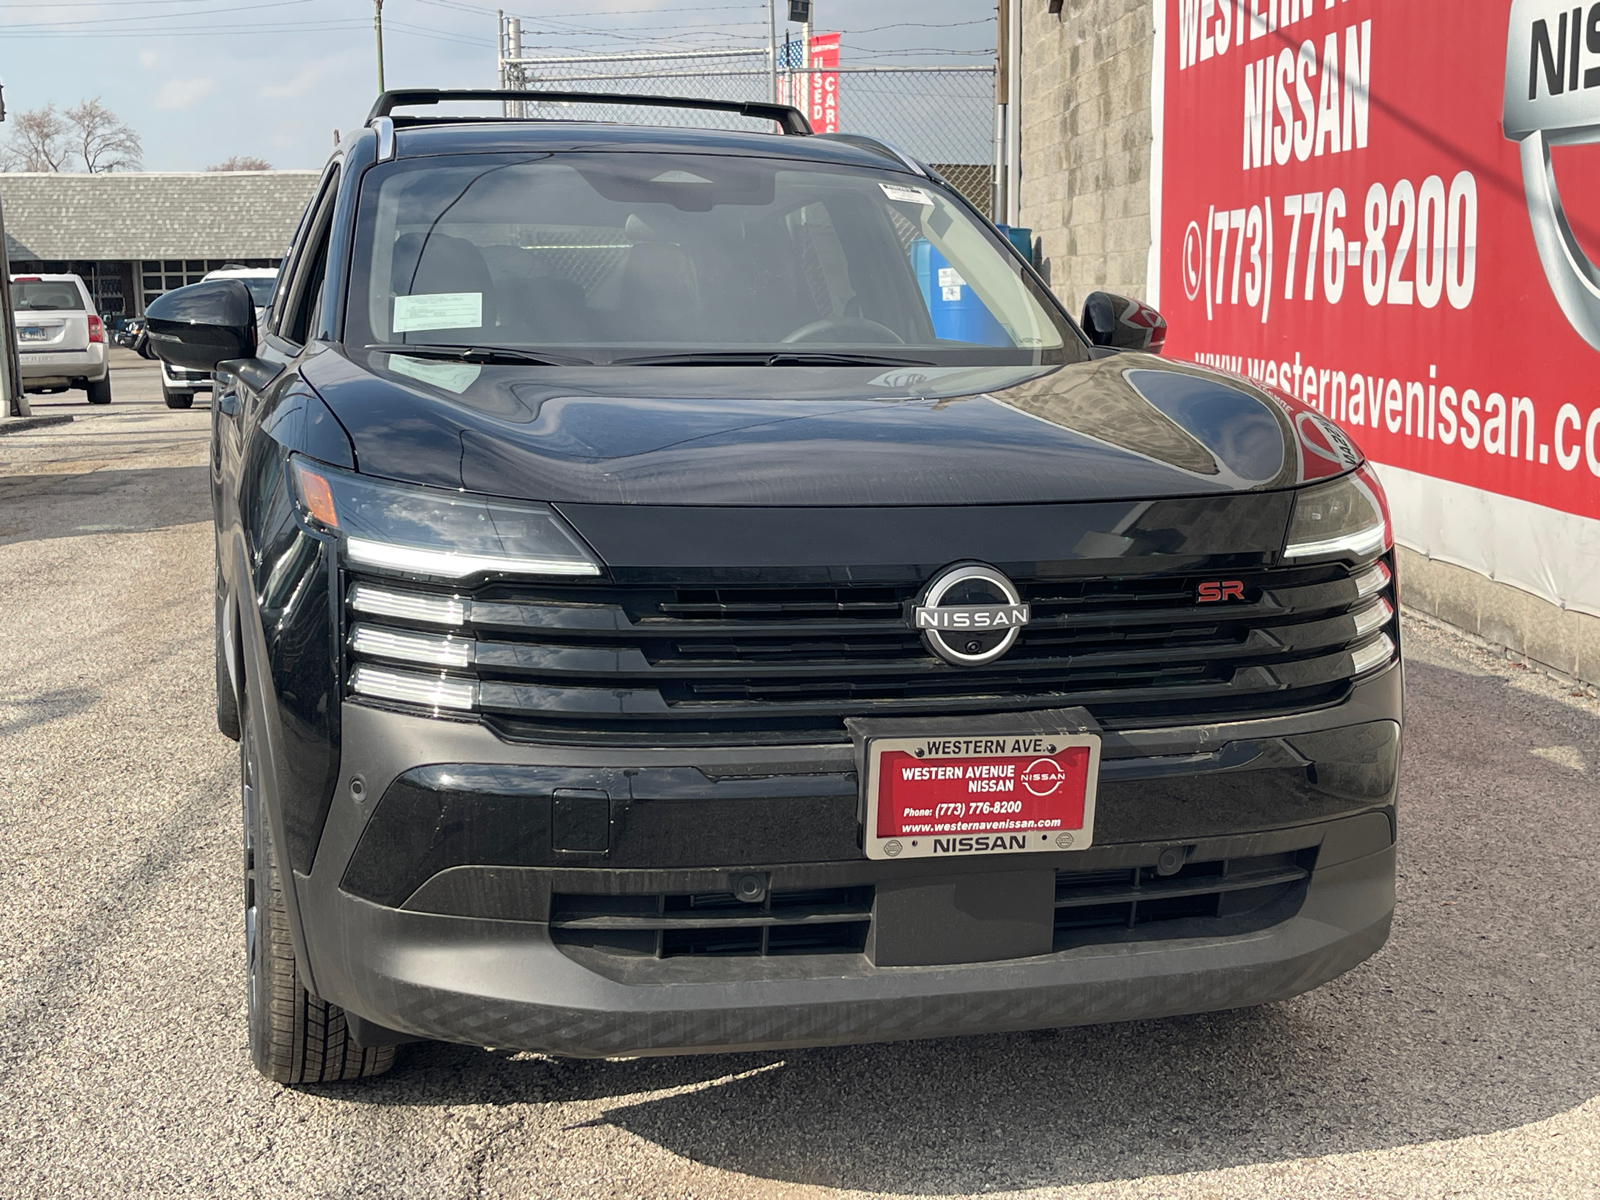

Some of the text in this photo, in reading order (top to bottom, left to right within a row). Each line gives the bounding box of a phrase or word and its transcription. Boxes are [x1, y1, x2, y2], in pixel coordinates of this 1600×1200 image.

[813, 56, 823, 120] USED
[1242, 19, 1372, 171] NISSAN
[824, 76, 836, 133] CARS
[1205, 170, 1478, 324] (773) 776-8200
[1195, 351, 1600, 478] westernavenissan.co
[1197, 580, 1245, 601] SR
[920, 608, 1027, 627] NISSAN
[926, 739, 1046, 755] WESTERN AVE.
[902, 765, 1016, 781] WESTERN AVENUE
[1020, 772, 1066, 782] NISSAN
[968, 779, 1014, 793] NISSAN
[903, 800, 1022, 819] Phone: (773) 776-8200
[902, 818, 1061, 833] www.westernavenissan.com
[933, 835, 1026, 853] NISSAN
